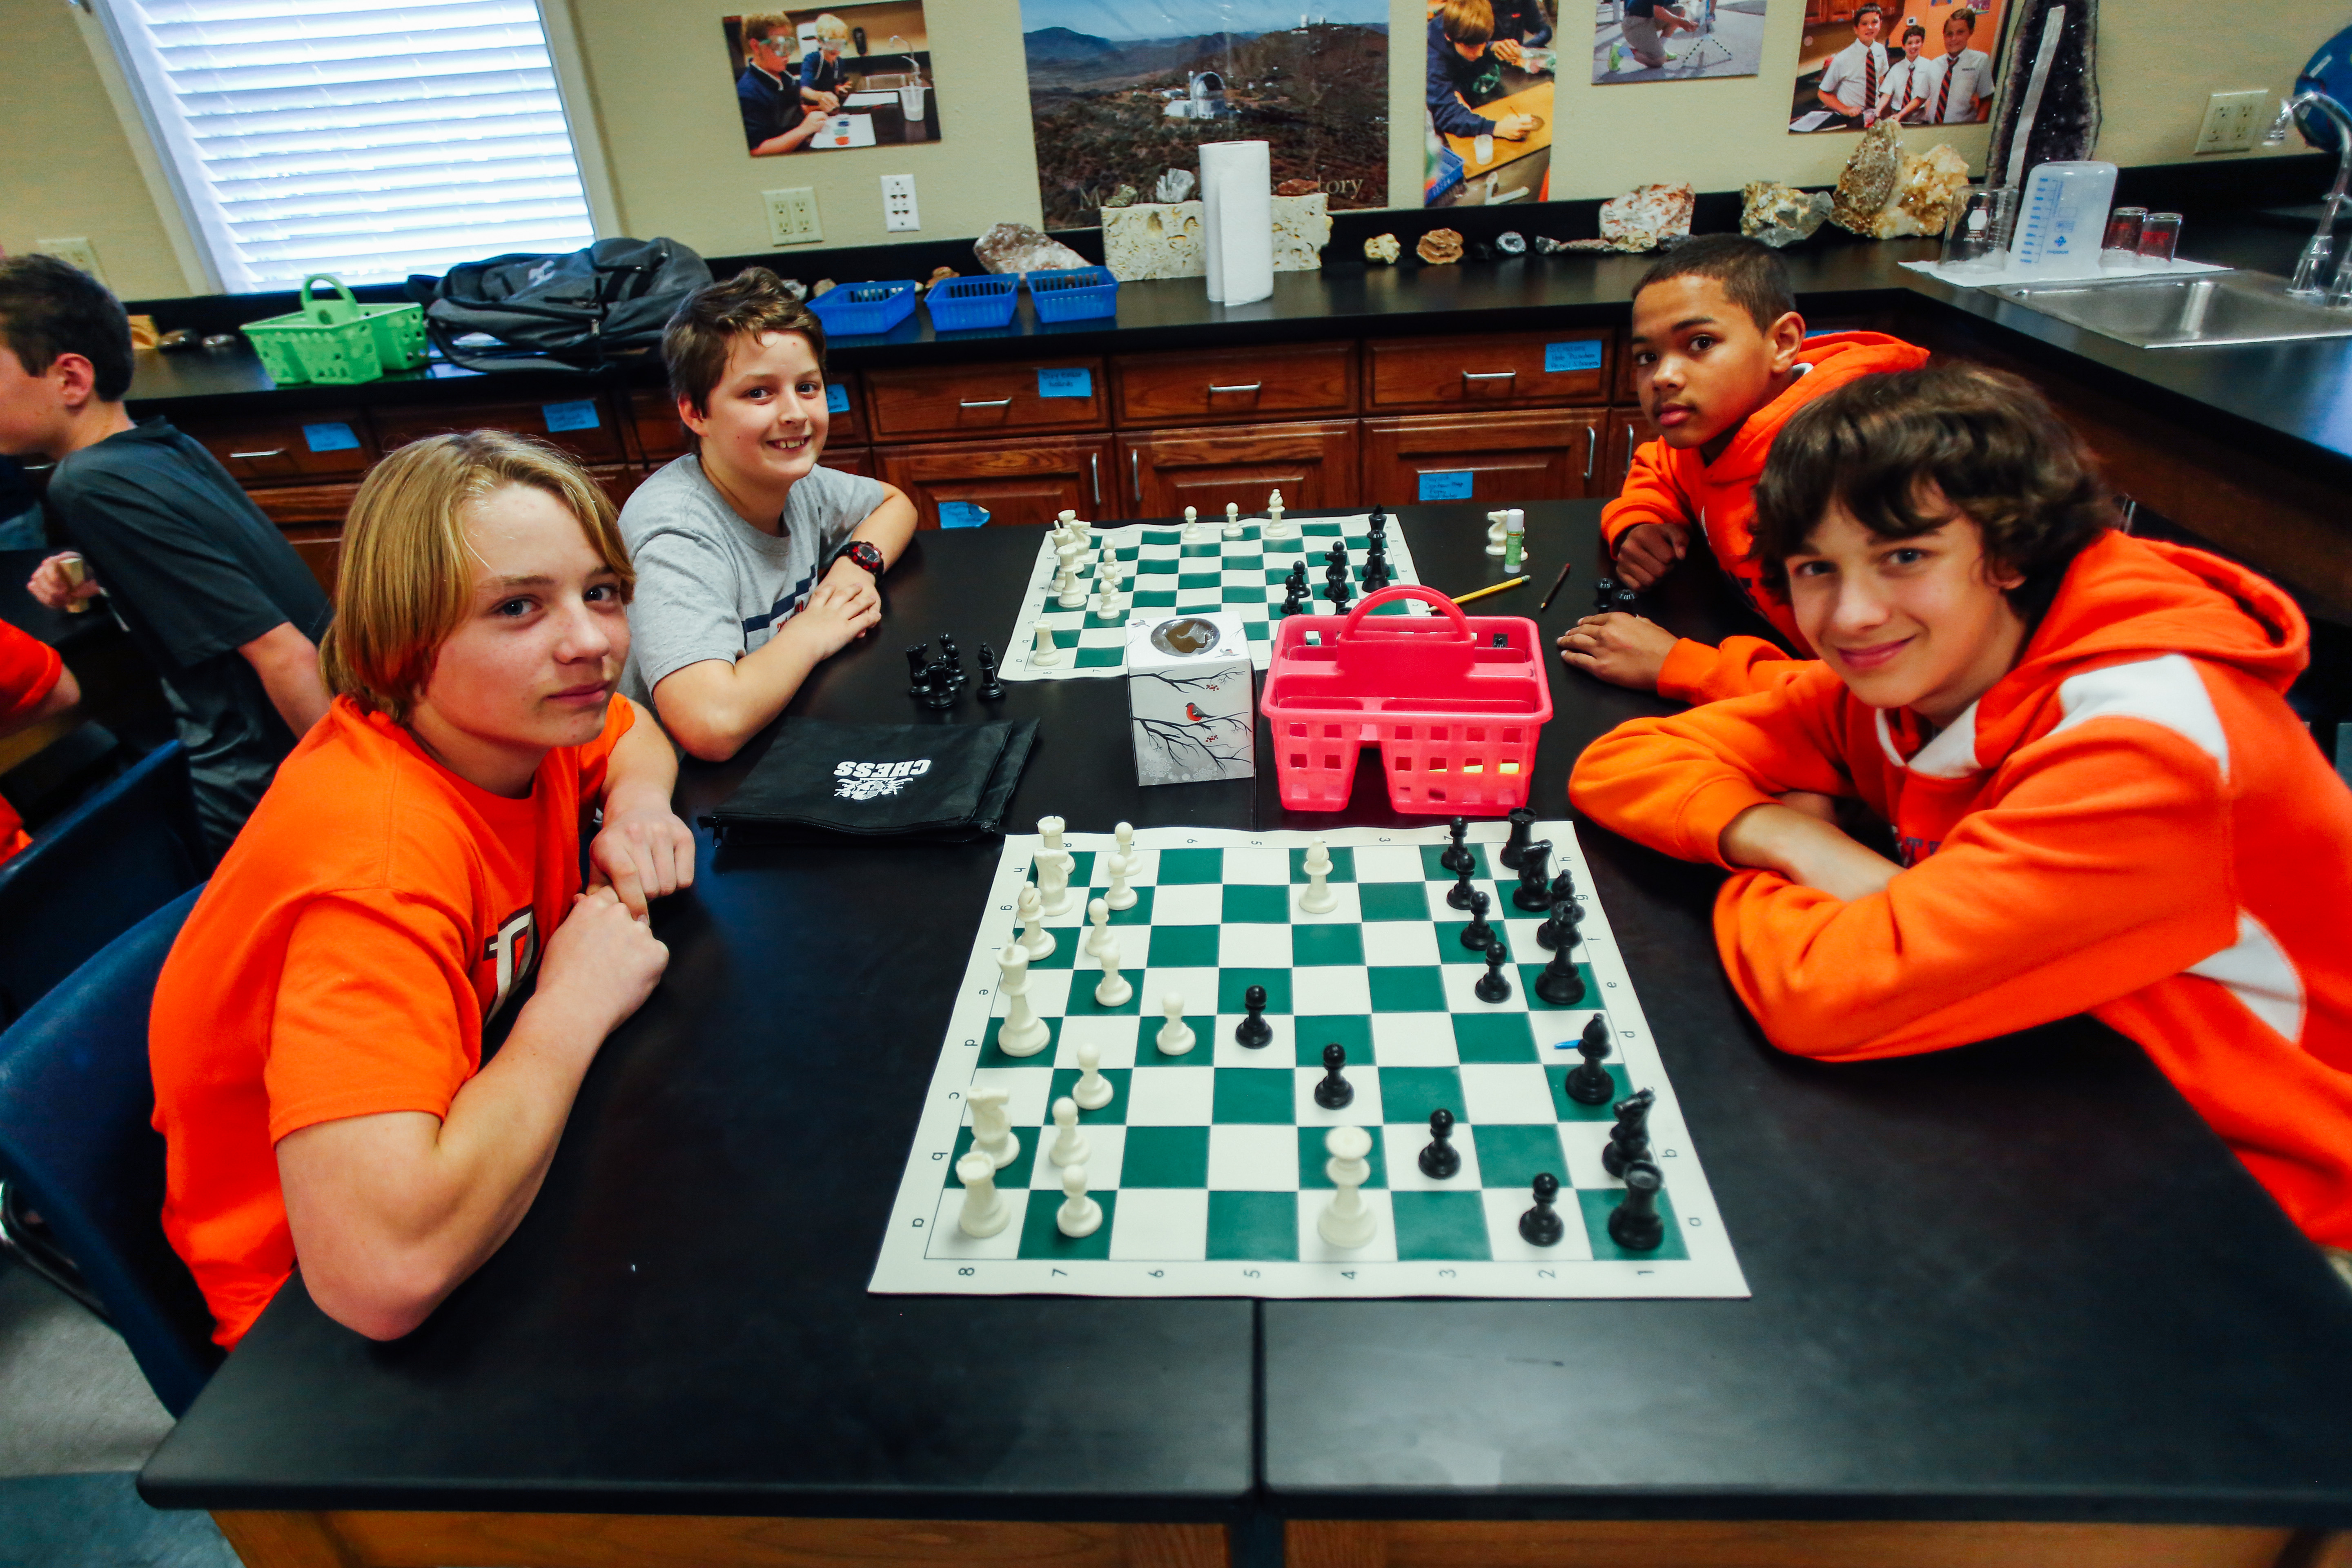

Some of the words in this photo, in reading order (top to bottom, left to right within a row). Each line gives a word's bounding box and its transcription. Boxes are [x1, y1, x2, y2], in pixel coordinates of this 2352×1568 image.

[833, 759, 932, 778] CHESS
[948, 1091, 960, 1100] c
[1619, 1030, 1635, 1038] d
[1662, 1148, 1678, 1158] b
[1688, 1217, 1702, 1227] a
[931, 1152, 949, 1160] b
[911, 1218, 925, 1227] a
[958, 1267, 976, 1276] 8
[1051, 1268, 1068, 1277] 7
[1148, 1270, 1165, 1278] 6
[1243, 1270, 1261, 1278] 5
[1341, 1271, 1358, 1280] 4
[1439, 1269, 1457, 1278] 3
[1537, 1270, 1556, 1278] 2
